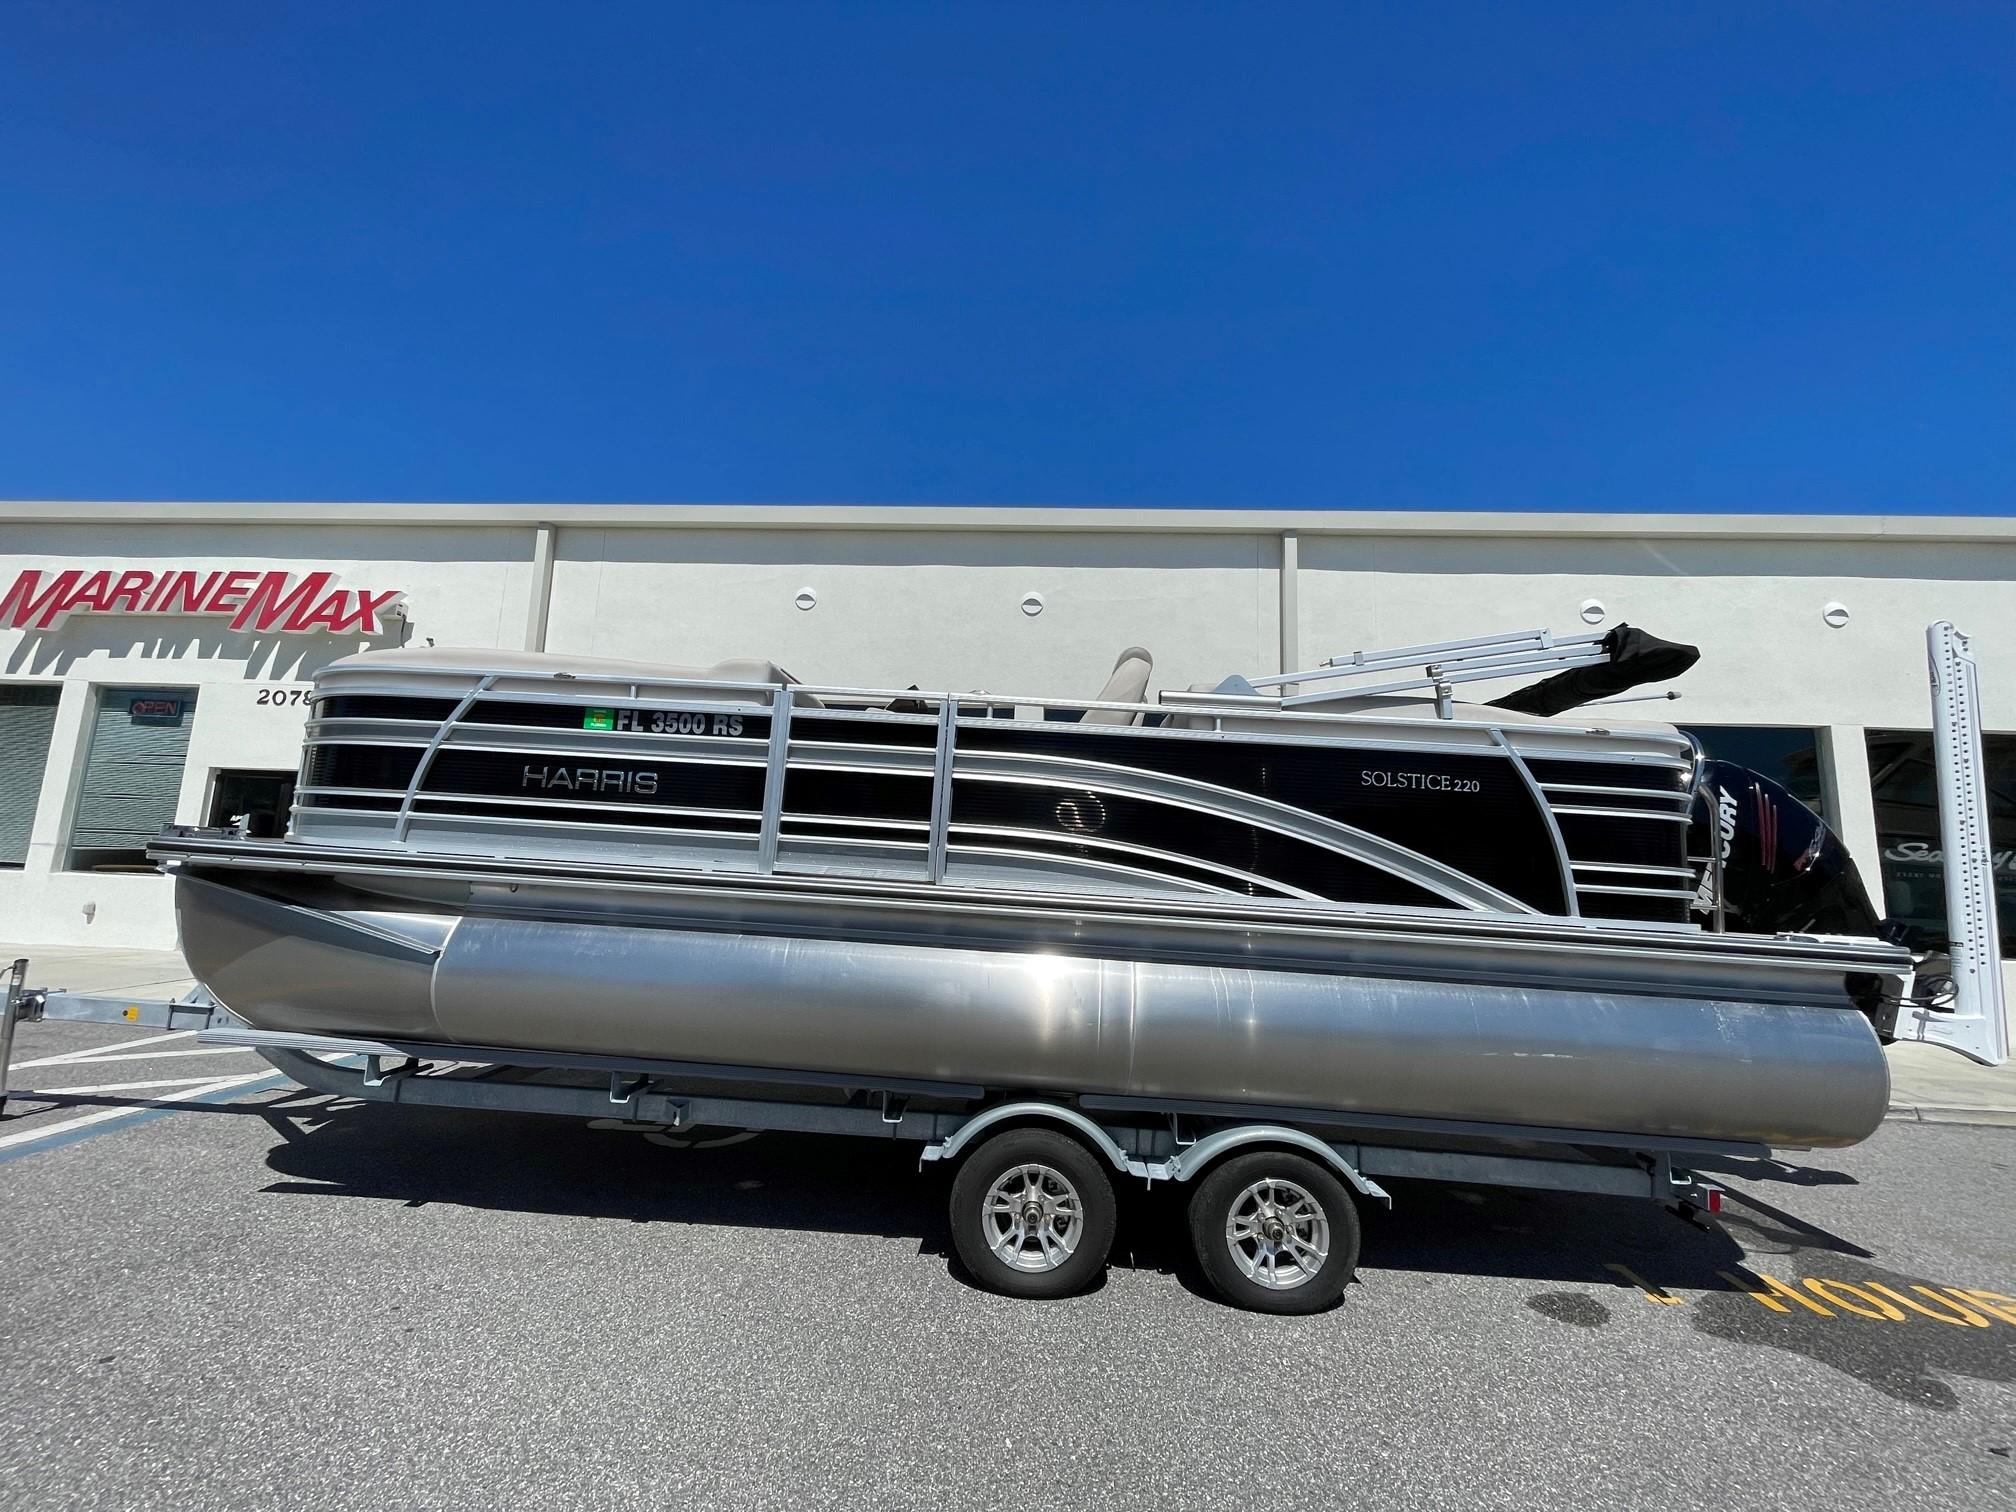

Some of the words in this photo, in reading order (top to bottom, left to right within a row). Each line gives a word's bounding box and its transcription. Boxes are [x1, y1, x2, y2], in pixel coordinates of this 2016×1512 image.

[132, 701, 177, 715] OPEN
[616, 709, 644, 732] FL
[650, 711, 706, 734] 3500
[712, 714, 744, 736] RS
[522, 765, 658, 794] HARRIS
[1361, 770, 1451, 791] SOLSTICE
[1453, 779, 1480, 792] 220
[1692, 784, 1738, 916] MECURY
